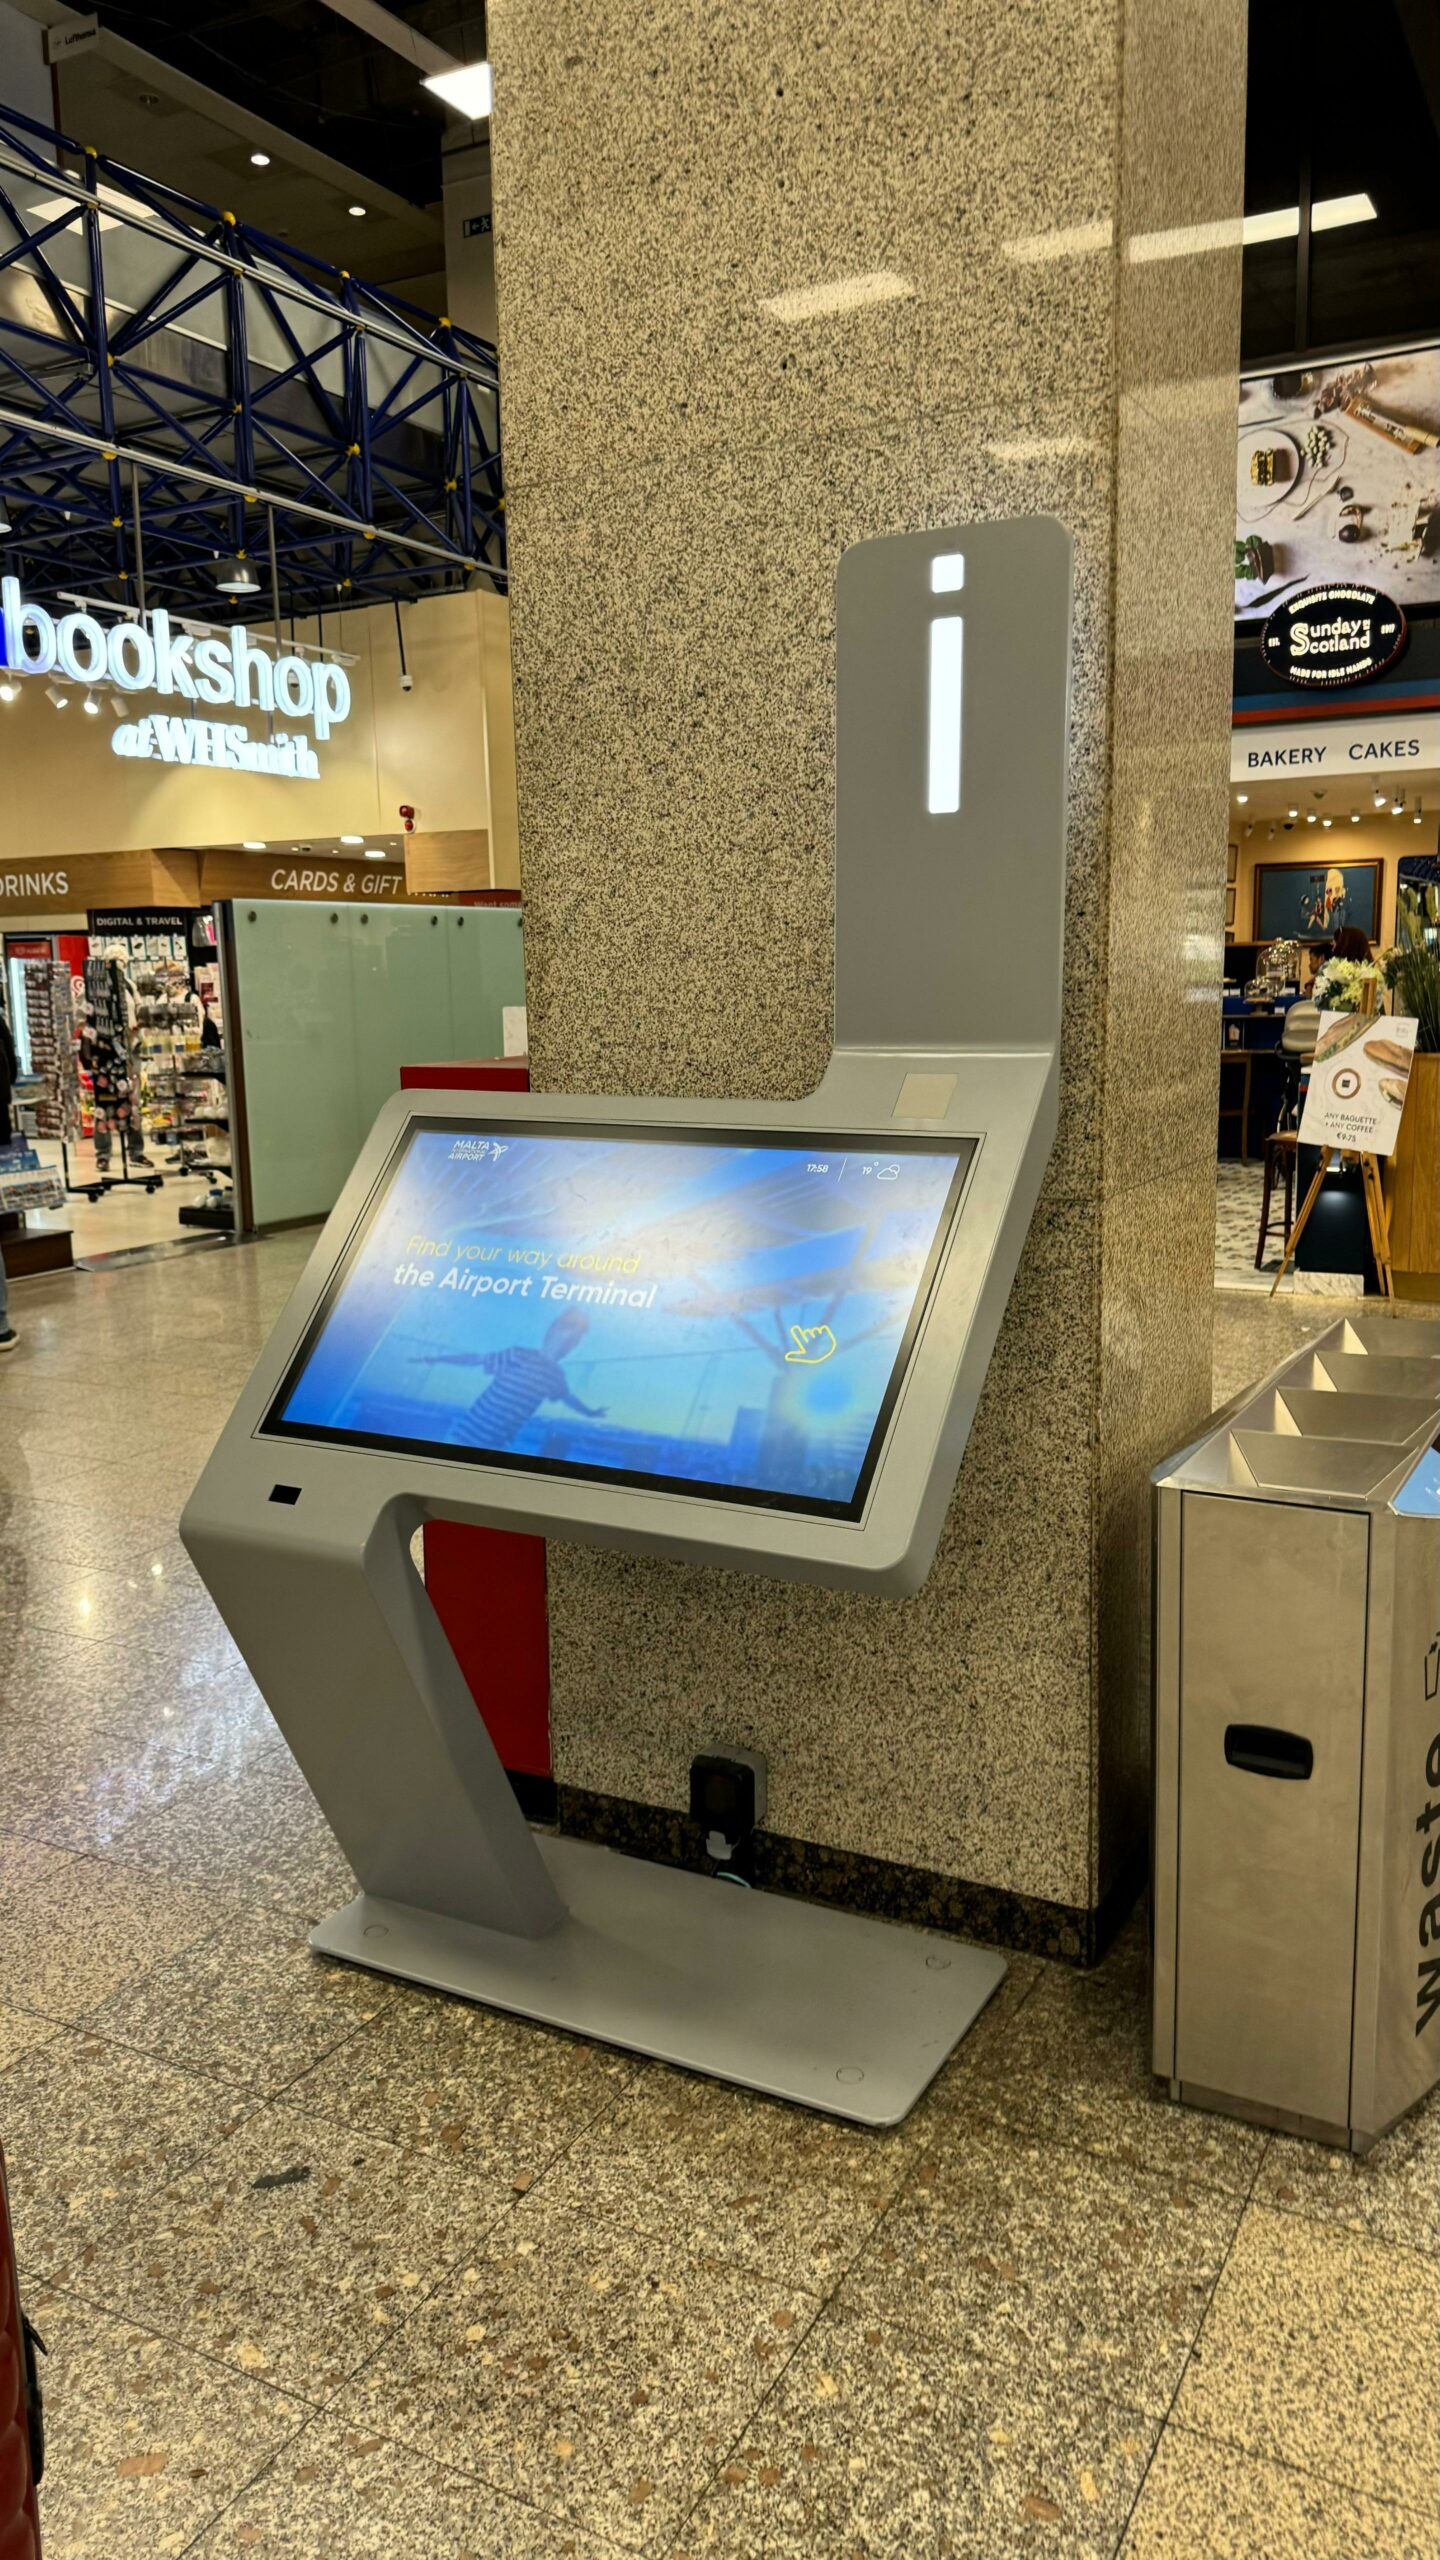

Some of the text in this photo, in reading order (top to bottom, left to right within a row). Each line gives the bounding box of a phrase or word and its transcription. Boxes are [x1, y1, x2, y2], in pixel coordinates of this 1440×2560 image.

[1328, 589, 1376, 605] CHOCOLATE
[1, 576, 351, 740] bookshop
[1311, 669, 1327, 679] FOR
[149, 714, 321, 779] WHSmith
[1247, 739, 1420, 768] BAKERY CAKES
[270, 868, 402, 895] CARDS & GIFT
[96, 916, 183, 926] DIGITAL & TRAVEL
[1340, 1113, 1377, 1125] BAGUETTE
[1346, 1123, 1374, 1133] COFFEE
[453, 1140, 490, 1151] MALTA
[447, 1151, 486, 1161] AIRPORT
[806, 1163, 829, 1174] 17:58
[405, 1234, 641, 1275] Find your way around
[392, 1262, 659, 1309] the Airport Terminal
